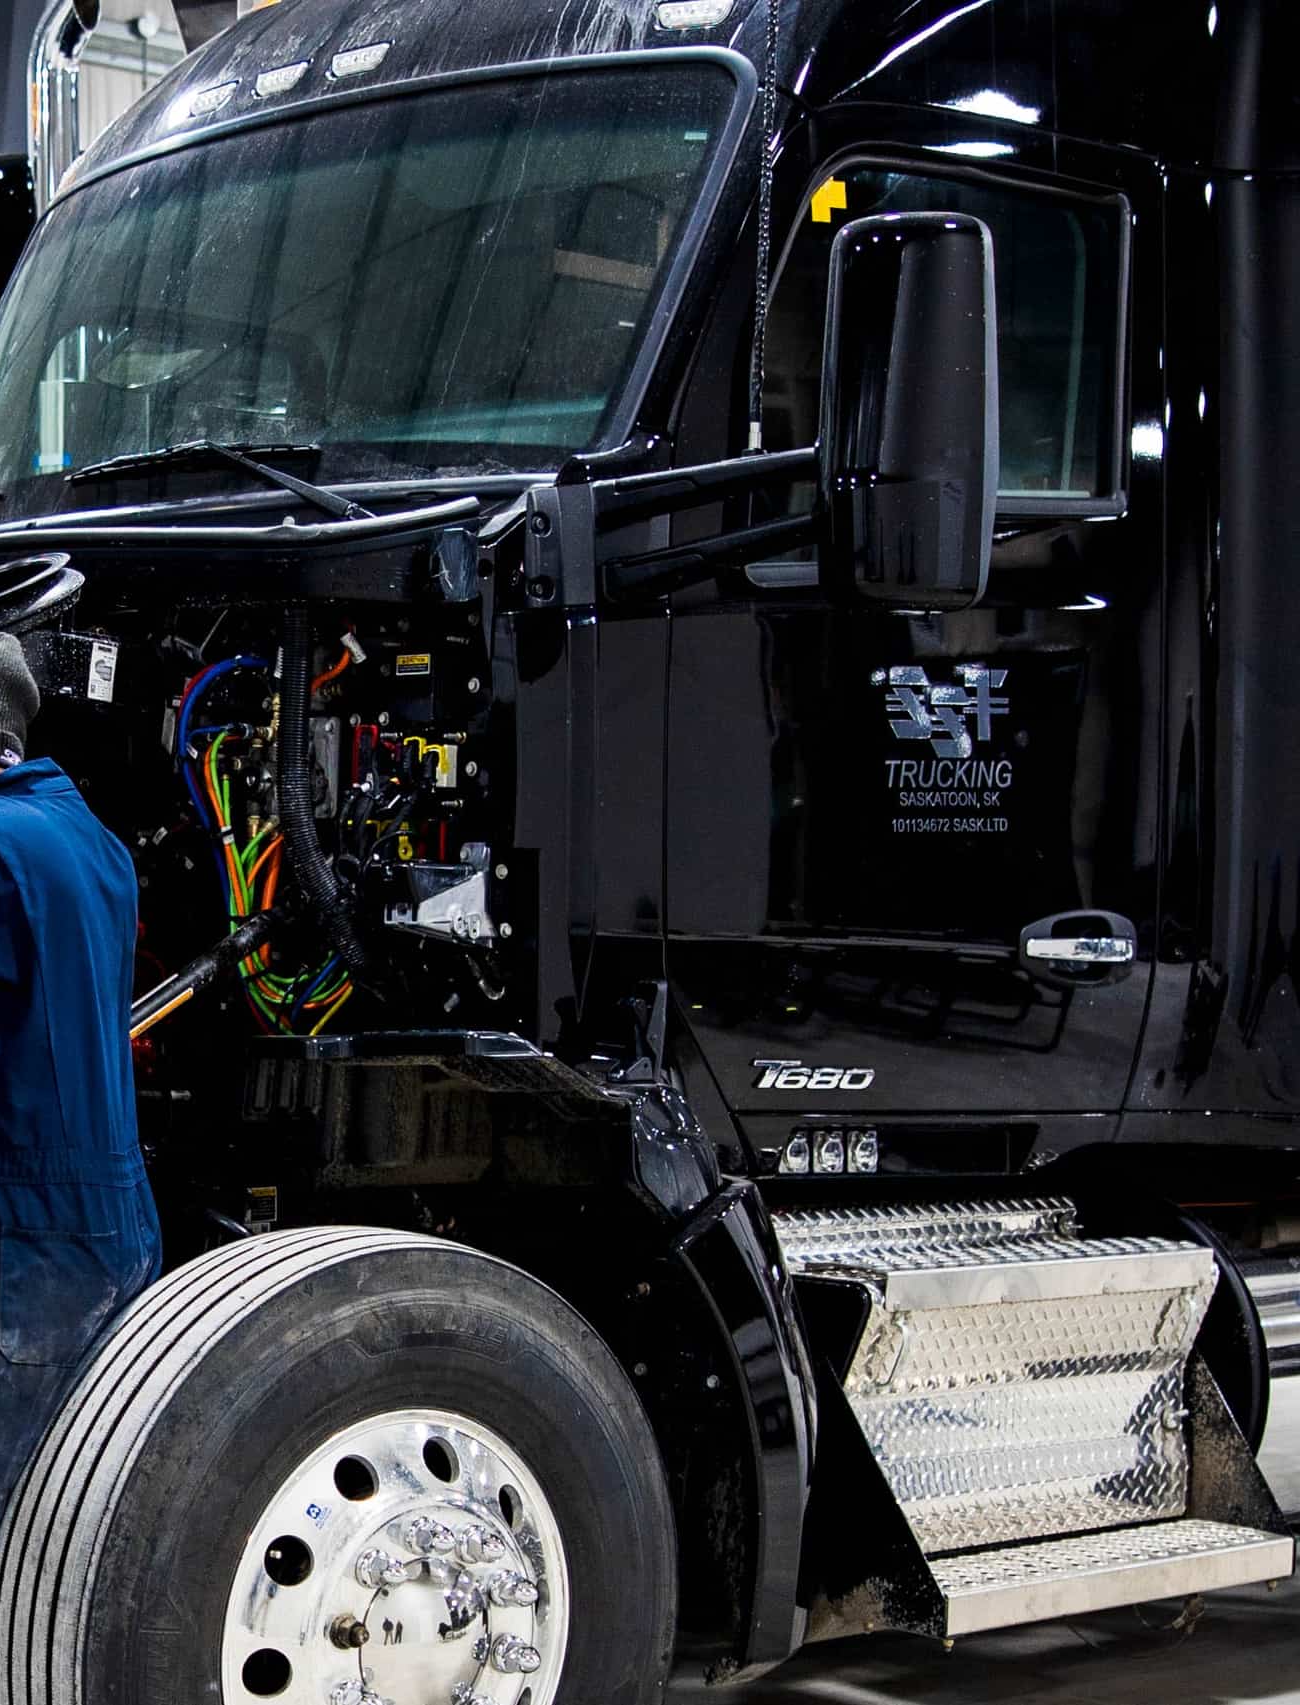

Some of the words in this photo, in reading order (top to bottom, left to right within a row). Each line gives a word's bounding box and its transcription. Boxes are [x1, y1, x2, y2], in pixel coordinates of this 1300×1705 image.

[885, 760, 1012, 788] TRUCKING
[900, 792, 980, 808] SASKATOON,
[983, 792, 1000, 806] SK
[891, 819, 950, 832] 101134672
[754, 1060, 875, 1089] T680
